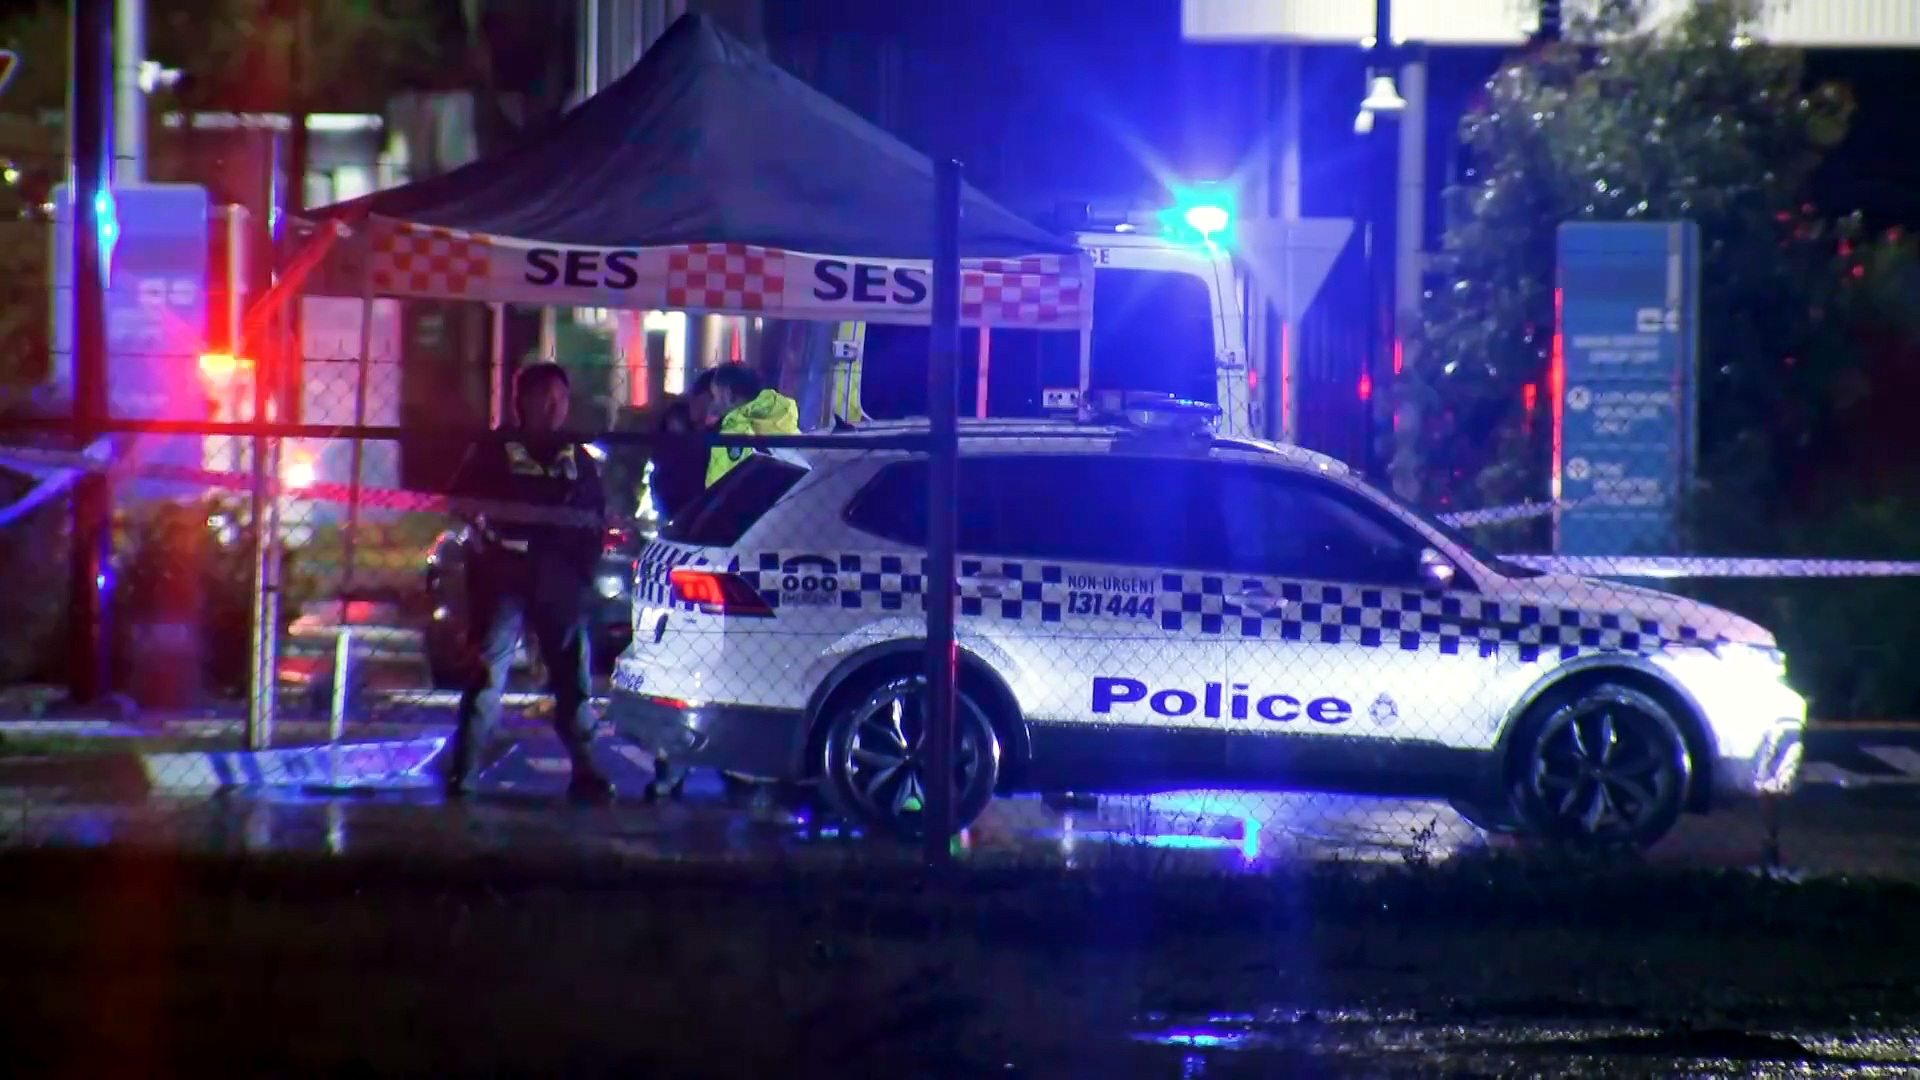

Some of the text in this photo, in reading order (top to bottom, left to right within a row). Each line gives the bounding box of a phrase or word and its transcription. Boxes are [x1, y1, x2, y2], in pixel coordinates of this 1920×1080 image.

[525, 248, 638, 289] SES
[813, 259, 927, 305] SES
[1067, 591, 1155, 619] 131 444
[1068, 575, 1155, 595] NON-URGENT
[1092, 677, 1352, 724] Police
